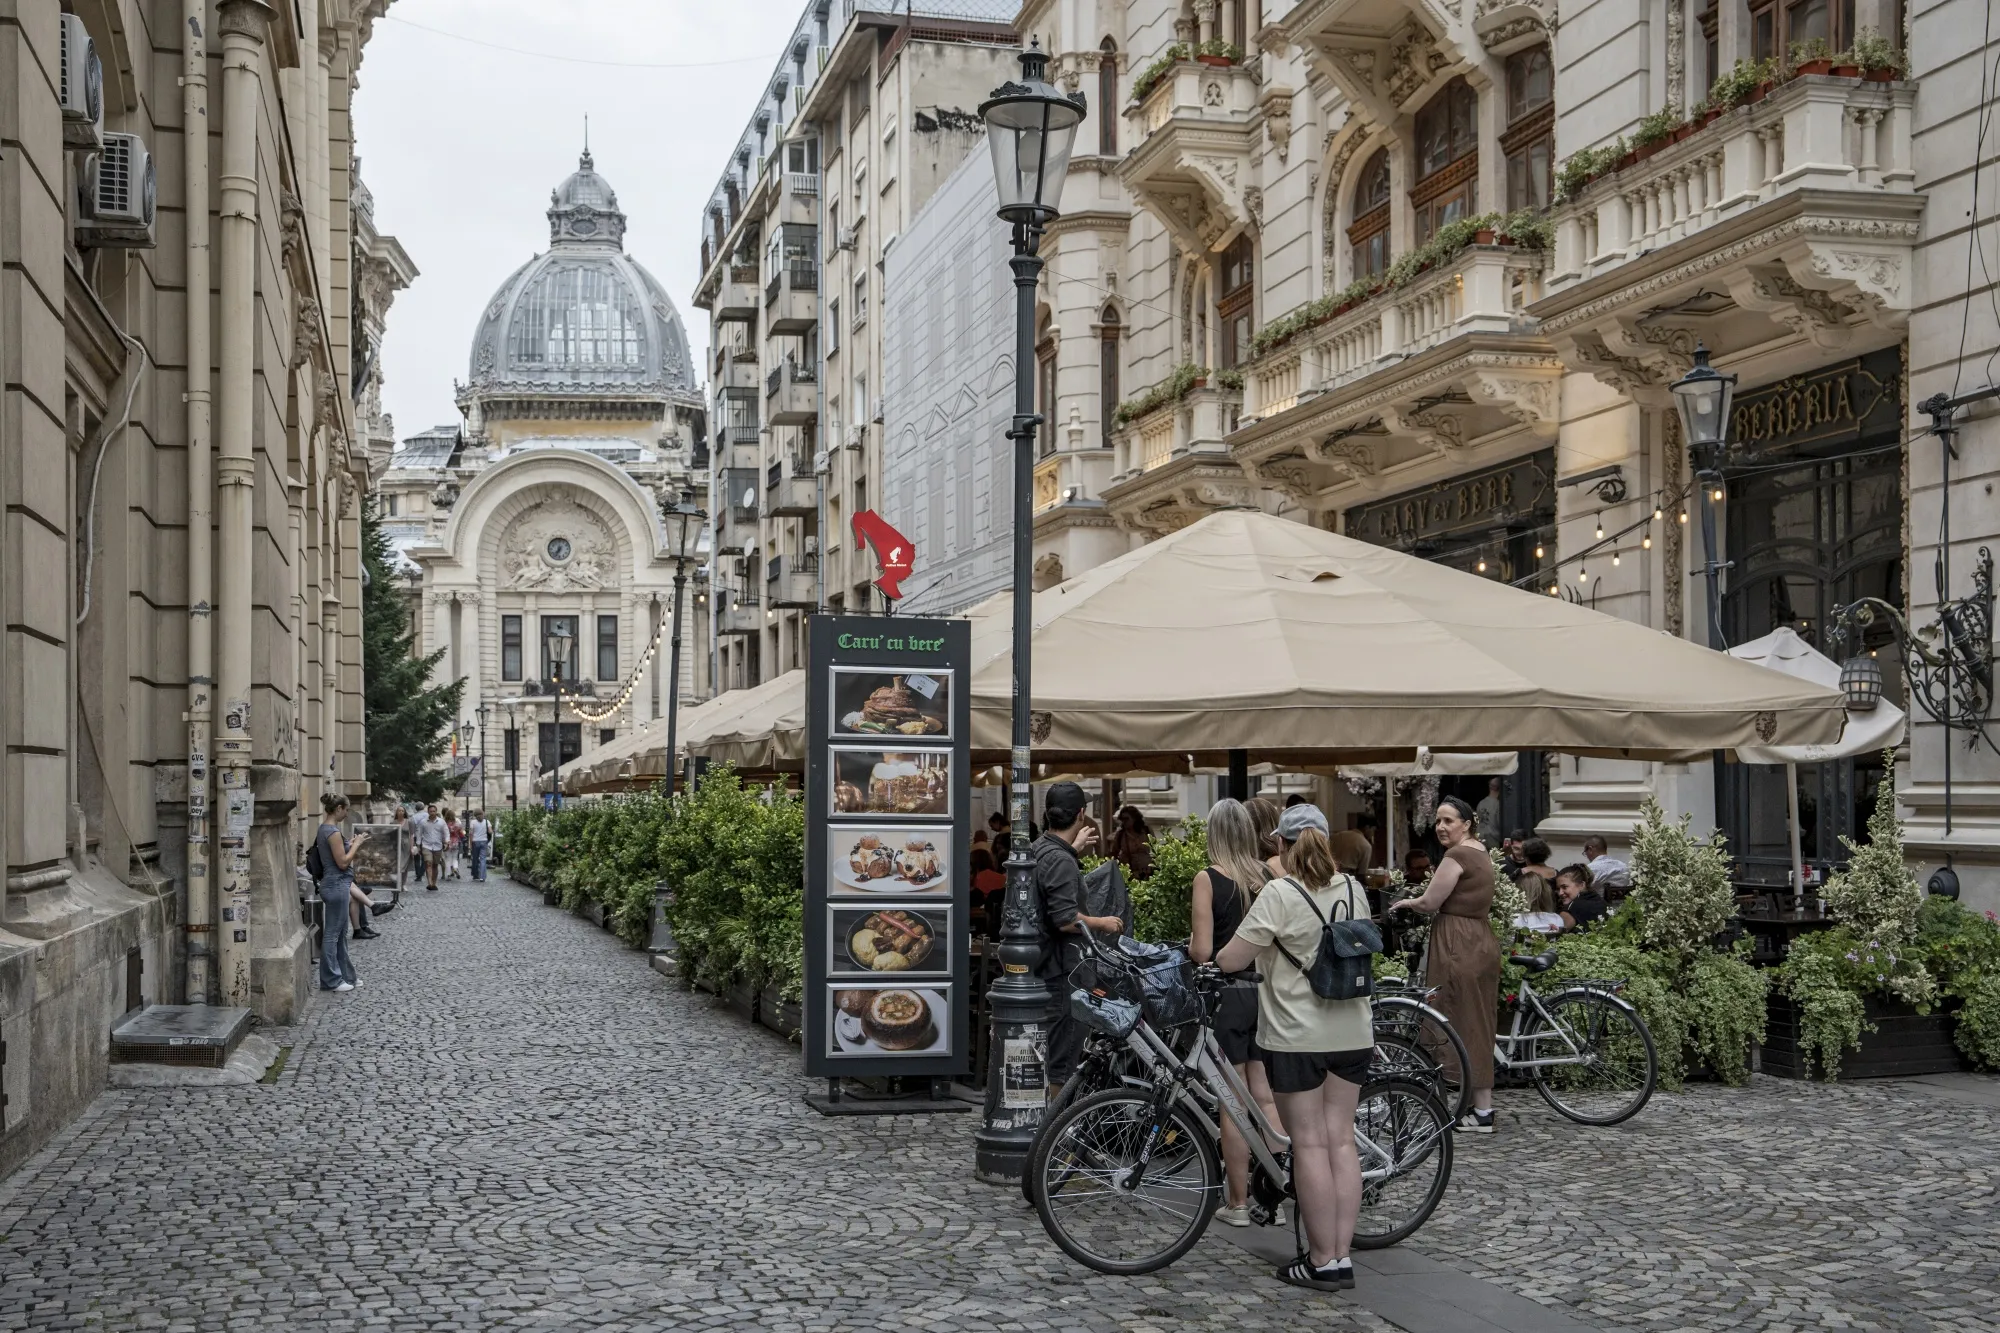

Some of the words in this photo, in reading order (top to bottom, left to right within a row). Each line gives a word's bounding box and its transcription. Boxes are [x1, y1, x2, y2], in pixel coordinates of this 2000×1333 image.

[1457, 472, 1513, 521] BERE
[838, 633, 884, 650] Caru'
[886, 637, 904, 651] cu
[1211, 1074, 1254, 1132] ROMET
